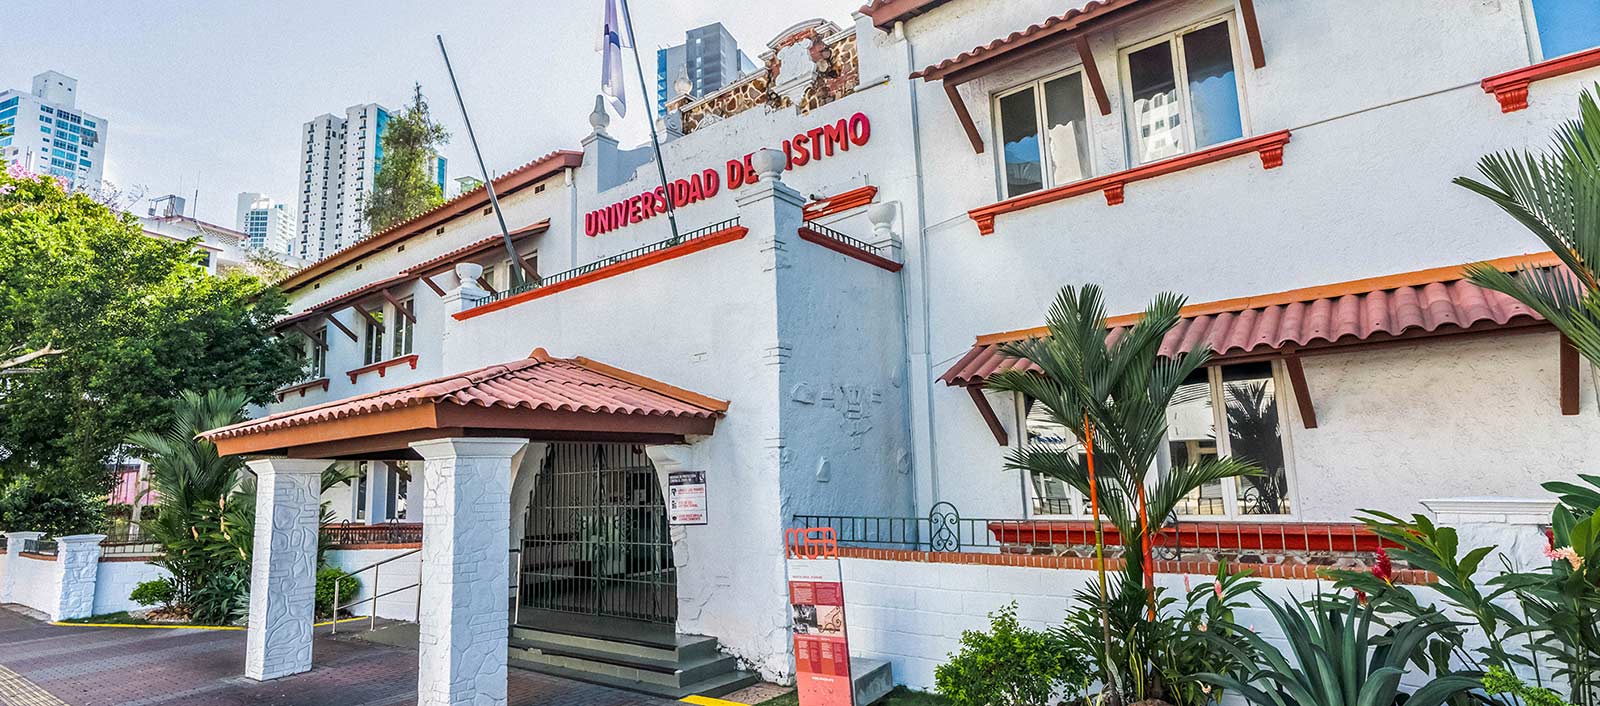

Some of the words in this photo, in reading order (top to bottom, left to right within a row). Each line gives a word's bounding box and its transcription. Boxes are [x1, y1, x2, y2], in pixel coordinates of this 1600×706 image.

[585, 168, 720, 237] UNIVERSIDAD
[727, 148, 767, 189] DE
[782, 112, 871, 171] ISTMO
